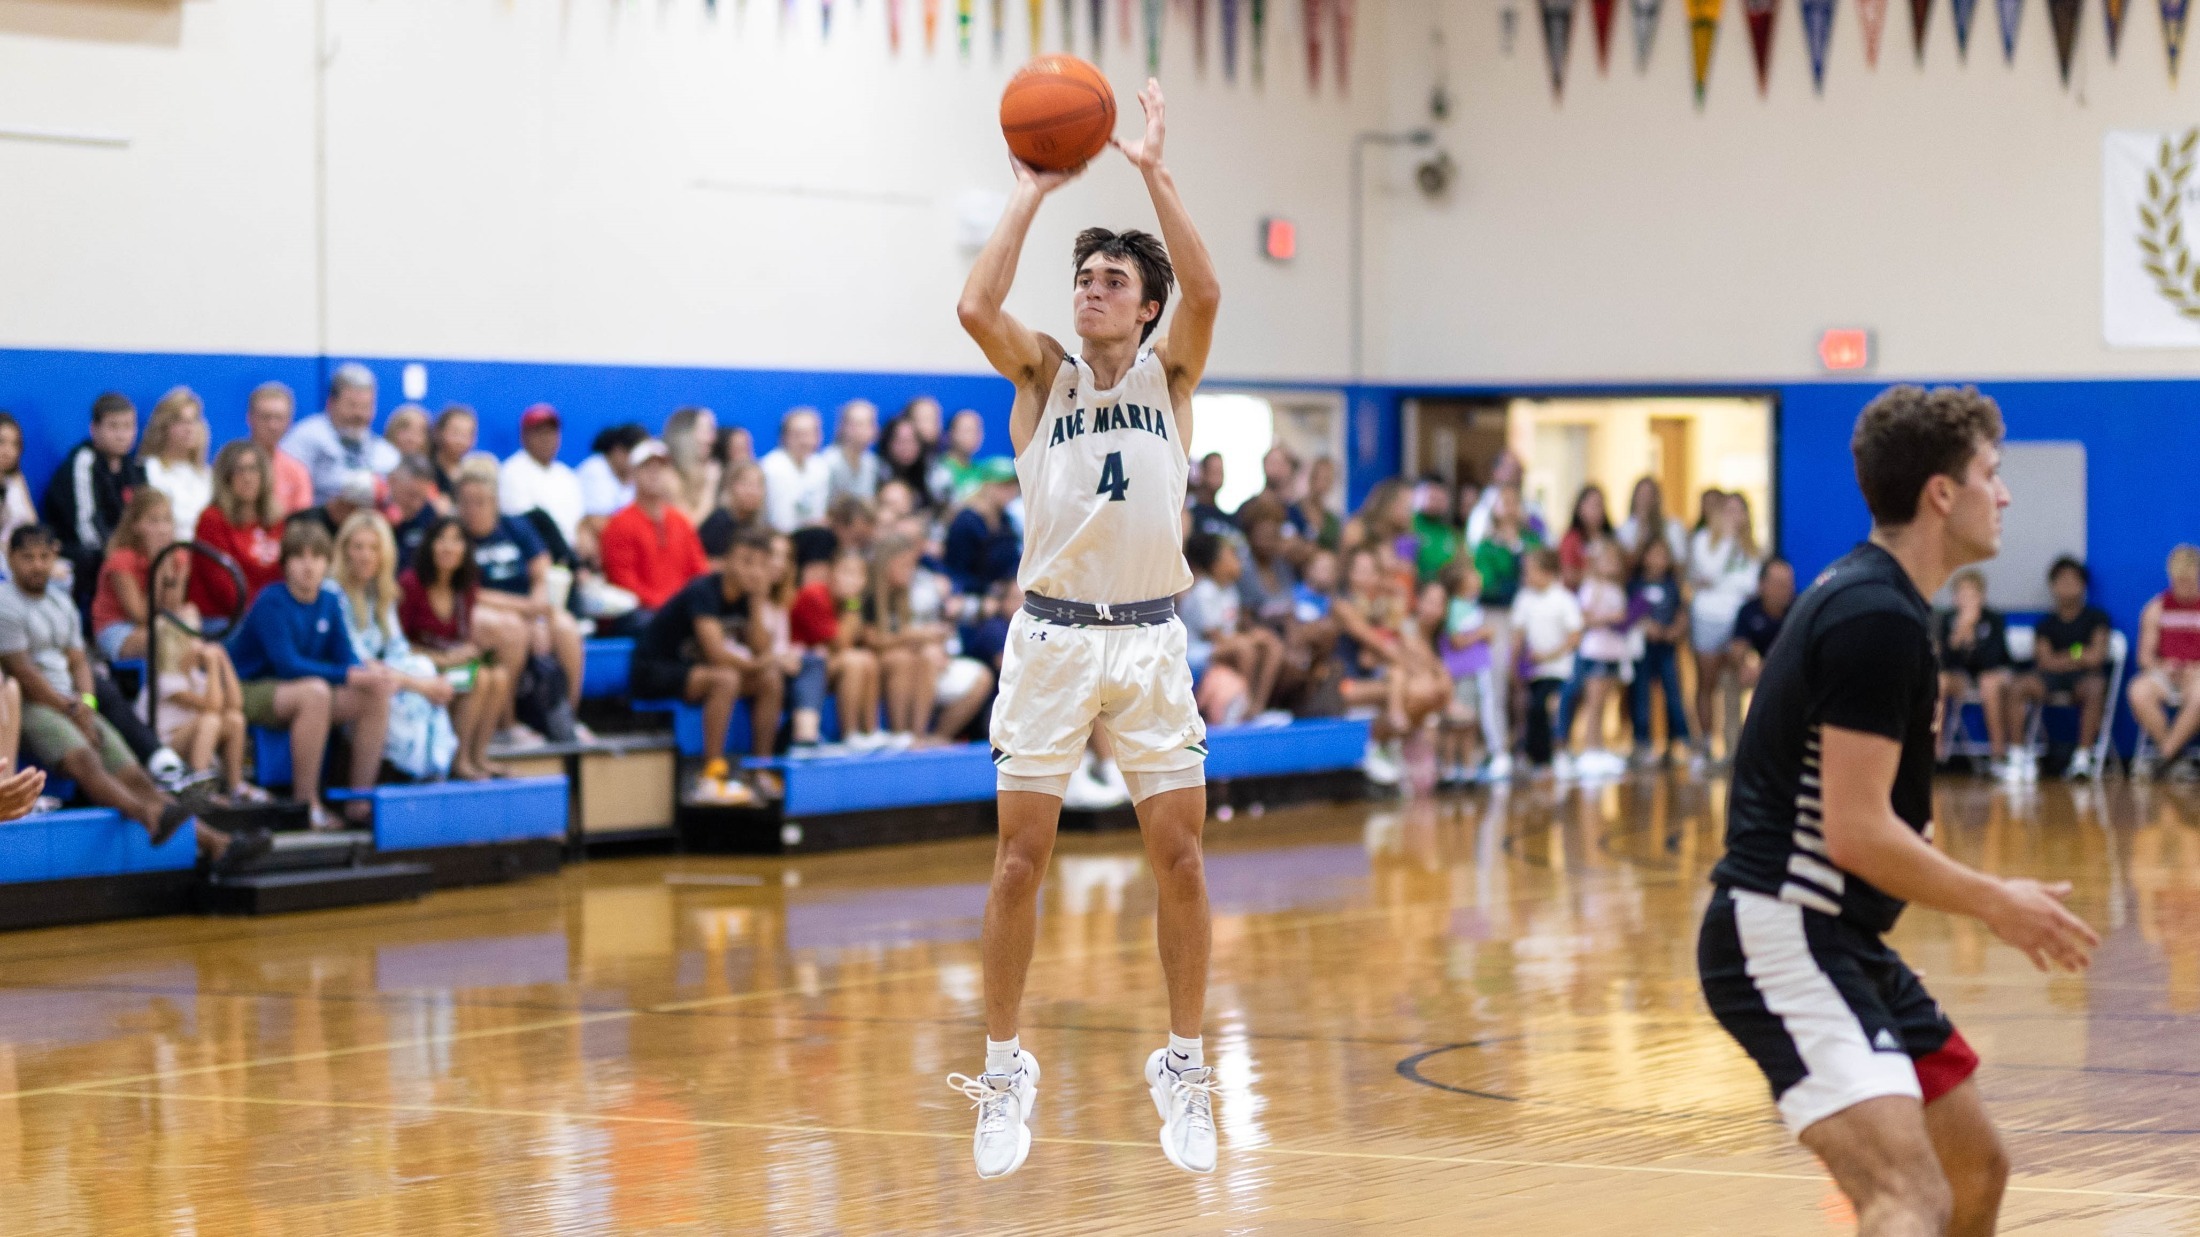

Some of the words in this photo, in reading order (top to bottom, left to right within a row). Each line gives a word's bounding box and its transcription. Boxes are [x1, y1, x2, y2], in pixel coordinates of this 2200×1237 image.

[1049, 409, 1086, 448] AVE
[1092, 404, 1168, 441] MARIA
[1096, 451, 1130, 501] 4
